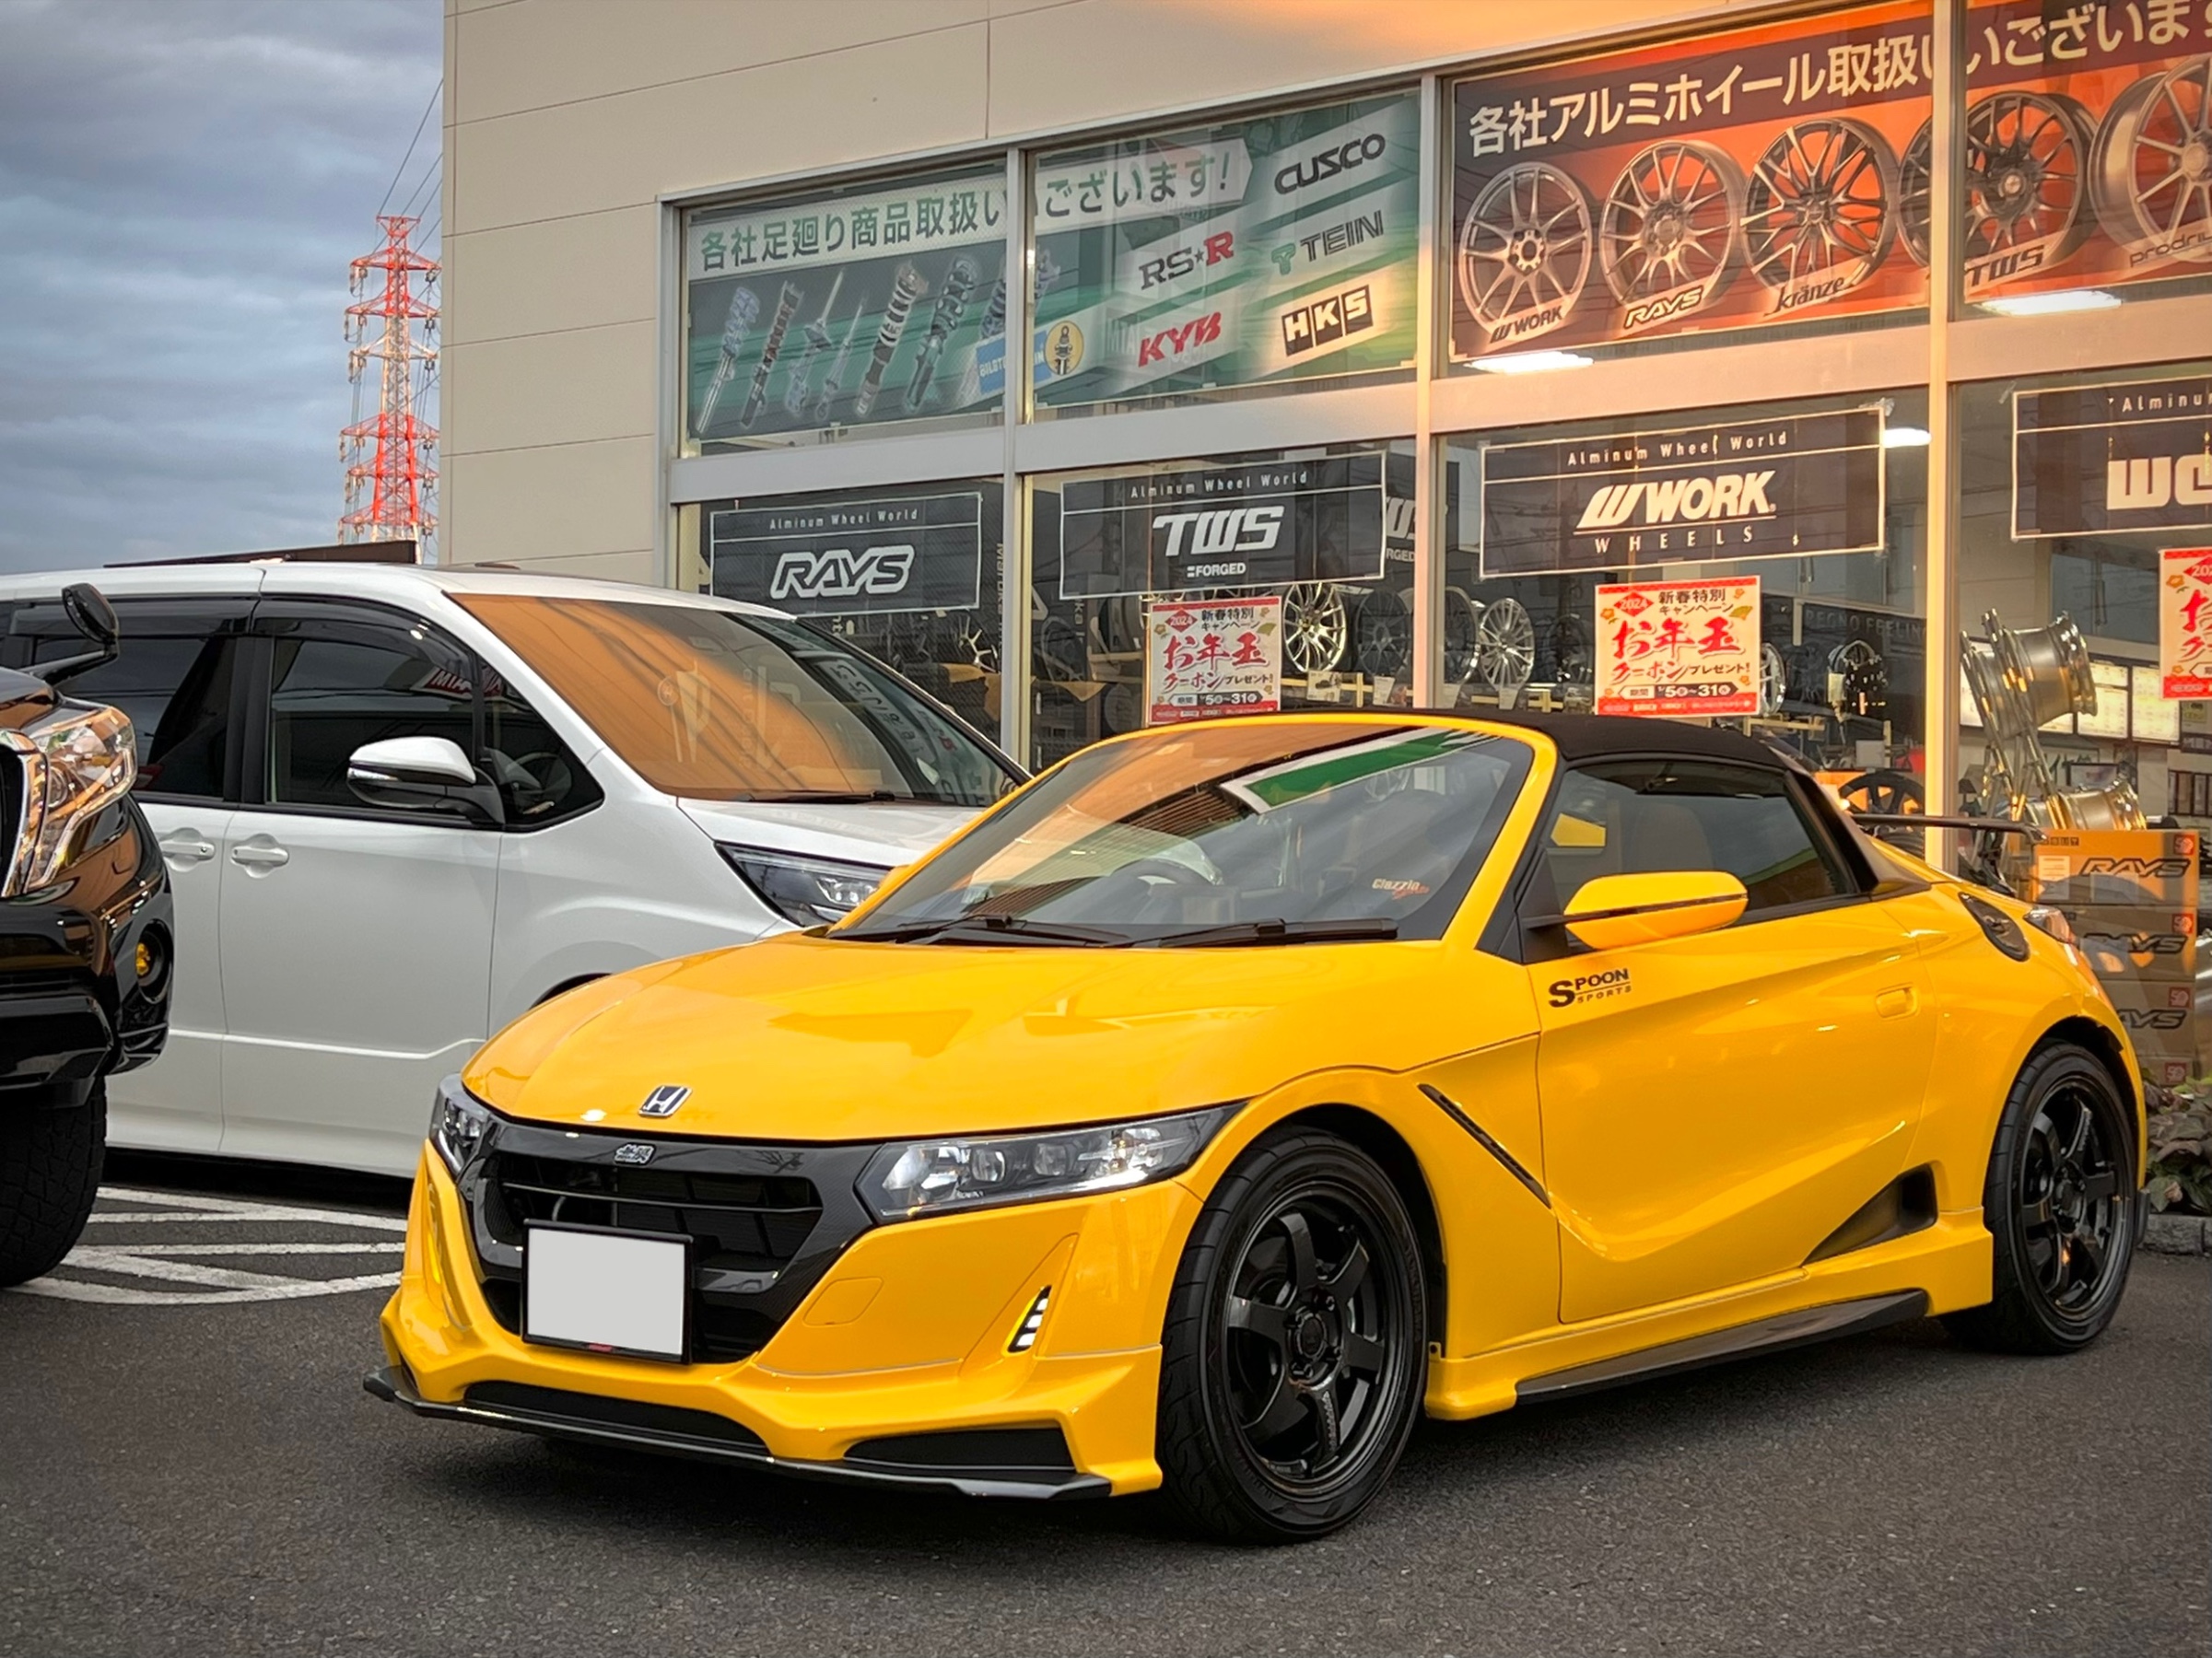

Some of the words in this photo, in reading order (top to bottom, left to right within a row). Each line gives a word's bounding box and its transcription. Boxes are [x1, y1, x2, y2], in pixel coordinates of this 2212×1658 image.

[1274, 134, 1386, 194] CUSCO
[1300, 210, 1385, 262] TEIN
[1969, 244, 2044, 286] TWS
[1624, 286, 1703, 330] RAYS
[1765, 276, 1845, 316] kränze
[1138, 311, 1222, 368] KYB
[1282, 285, 1374, 356] HKS
[1513, 306, 1563, 338] WORK
[1568, 448, 1648, 466] Alminum
[1661, 436, 1717, 458] Wheel
[1730, 431, 1787, 450] World
[1130, 483, 1195, 499] Alminum
[1204, 475, 1251, 493] Wheel
[1260, 471, 1308, 486] World
[1644, 471, 1776, 524] WORK
[769, 515, 825, 531] Alminum
[831, 510, 871, 526] Wheel
[878, 508, 919, 522] World
[1152, 505, 1285, 557] TWS
[1595, 526, 1753, 554] WHEELS
[770, 544, 915, 599] RAYS
[1194, 562, 1246, 578] FORGED
[1620, 598, 1648, 610] 2024
[1658, 589, 1726, 604] 新春特別
[1659, 604, 1733, 615] キャンペーン
[1164, 632, 1267, 671] お年玉
[1612, 616, 1741, 659] お年玉
[2079, 858, 2191, 877] RAYS
[1549, 968, 1629, 1008] SPOON
[1577, 986, 1632, 1003] SPORTS
